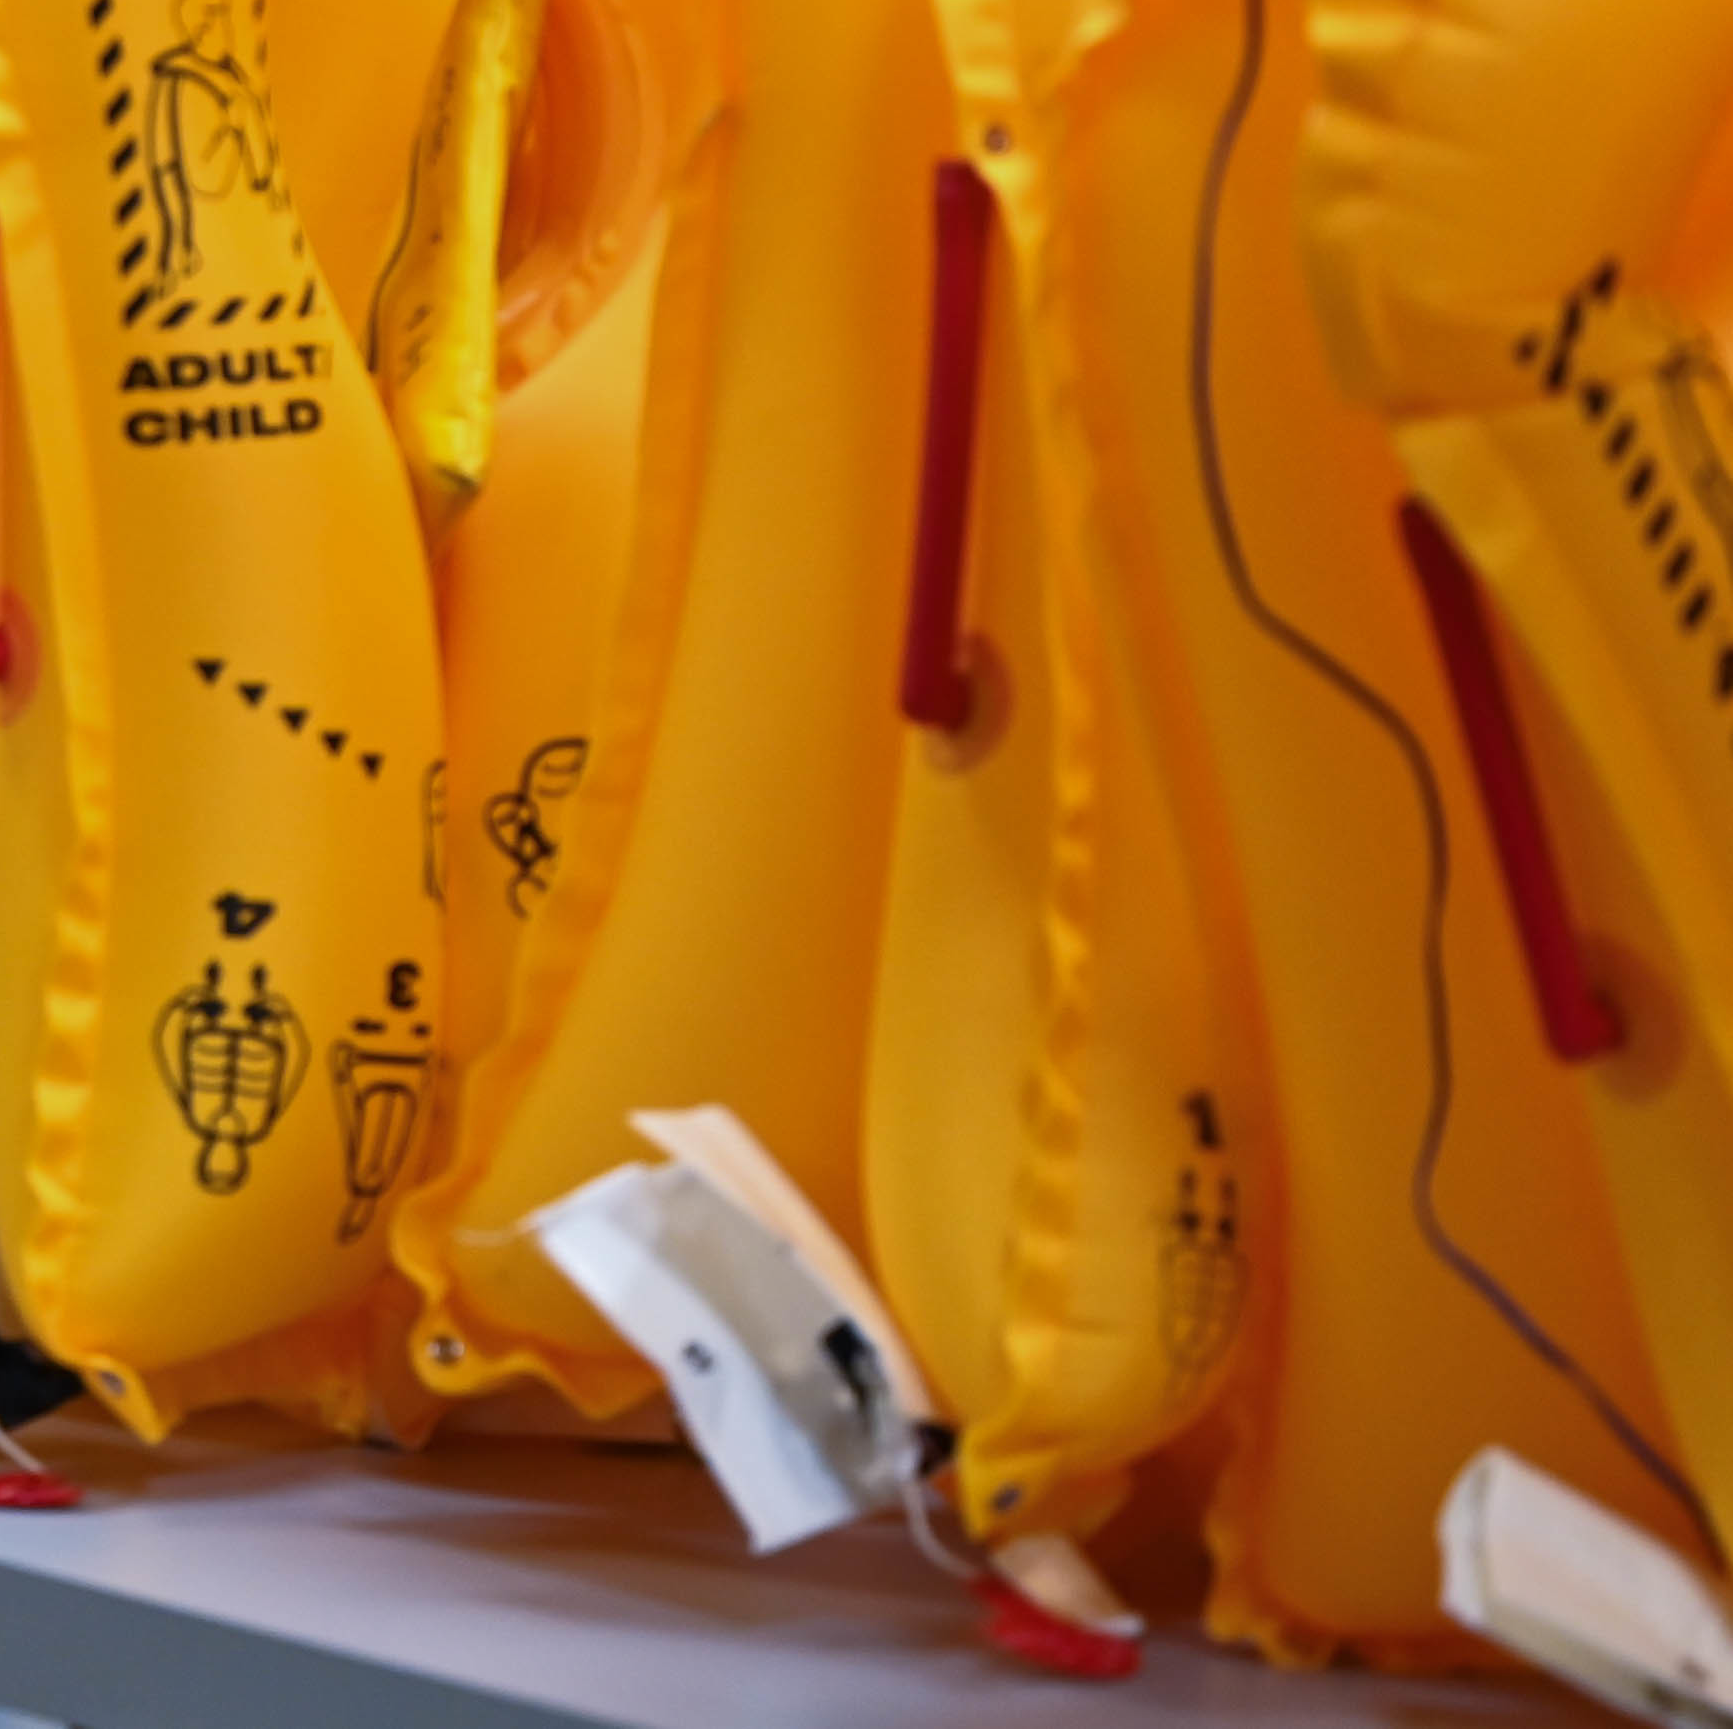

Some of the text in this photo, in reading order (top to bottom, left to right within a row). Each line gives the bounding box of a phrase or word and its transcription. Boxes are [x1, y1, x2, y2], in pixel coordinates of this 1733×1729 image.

[123, 396, 324, 451] CHILD
[212, 890, 278, 939] 4
[386, 961, 421, 1010] 3
